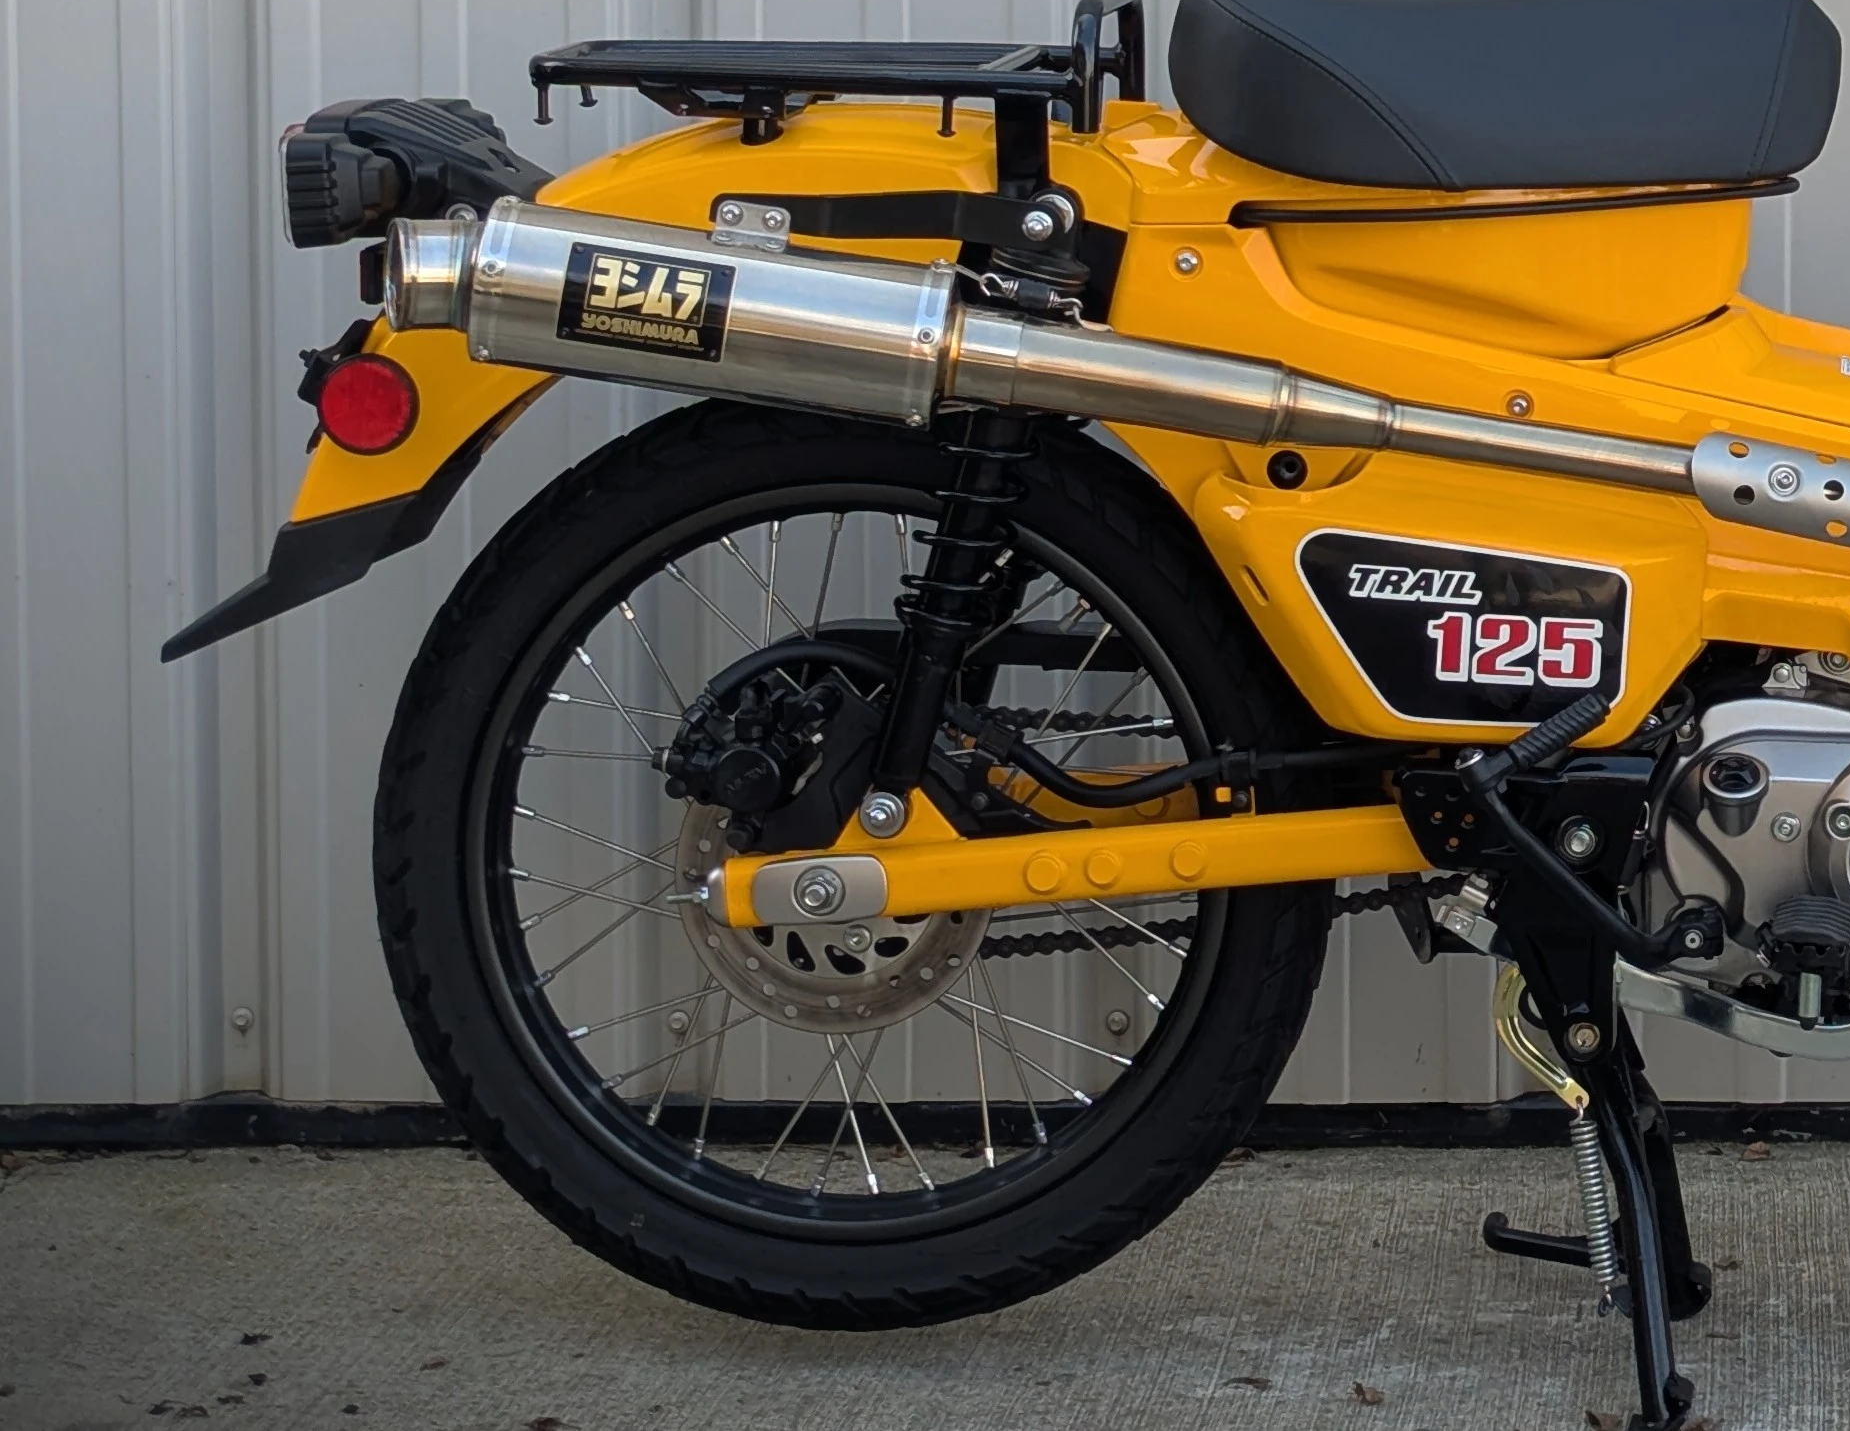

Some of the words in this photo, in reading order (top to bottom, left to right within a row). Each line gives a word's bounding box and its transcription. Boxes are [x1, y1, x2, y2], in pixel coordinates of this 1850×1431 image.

[590, 258, 705, 320] ヨシムラ
[581, 313, 699, 345] YOSHIMURA
[1349, 564, 1482, 605] TRAIL
[1427, 611, 1603, 688] 125
